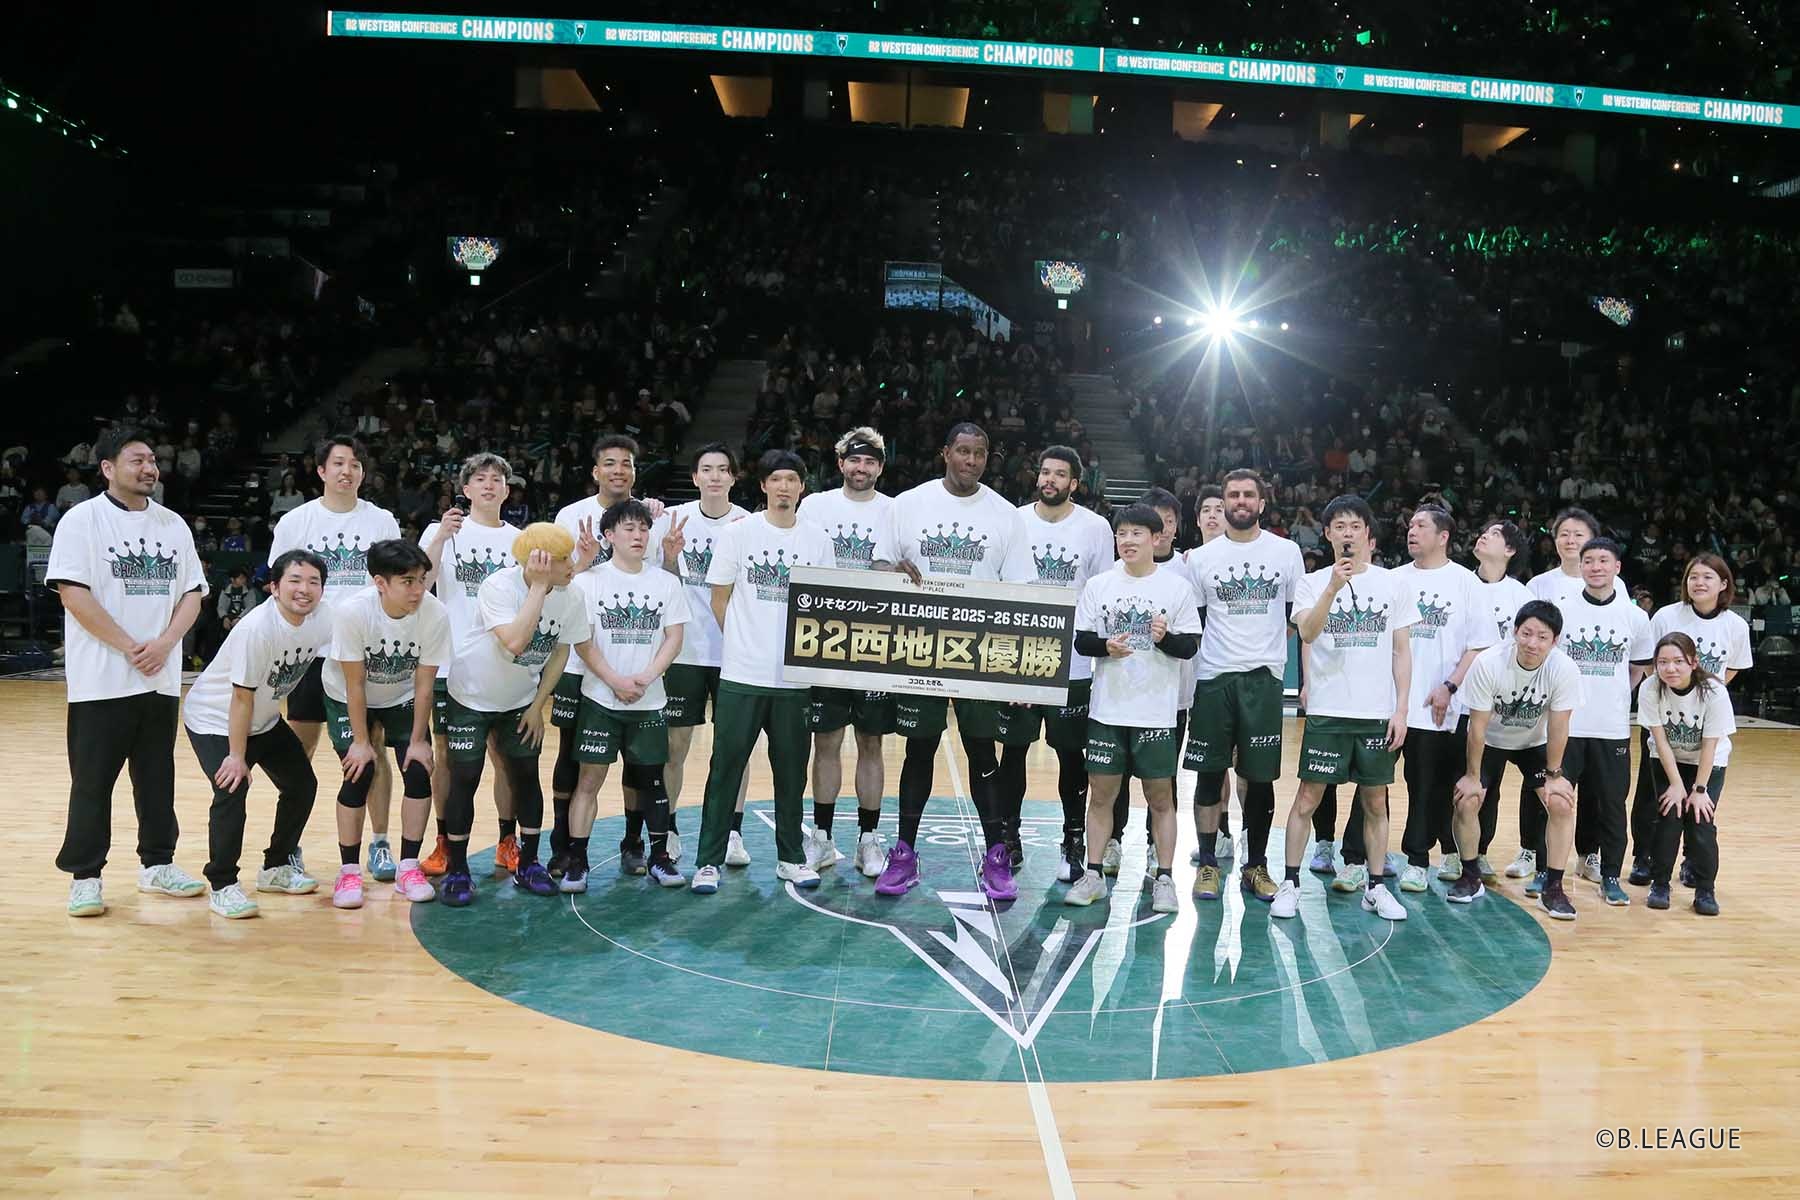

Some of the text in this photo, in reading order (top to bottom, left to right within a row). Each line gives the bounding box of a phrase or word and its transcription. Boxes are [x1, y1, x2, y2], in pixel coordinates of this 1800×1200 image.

[345, 18, 554, 41] B2 WESTERN CONFERENCE CHAMPIONS
[605, 28, 813, 52] B2 WESTERN CONFERENCE CHAMPIONS
[868, 40, 1073, 67] B2 WESTERN CONFERENCE CHAMPIONS
[1116, 55, 1315, 84] B2 WESTERN CONFERENCE CHAMPIONS
[1363, 73, 1553, 104] B2 WESTERN CONFERENCE CHAMPIONS
[1602, 94, 1784, 125] B2 WESTERN CONFERENCE CHAMPIONS
[920, 541, 985, 562] CHAMPIONS
[747, 567, 790, 589] CHAMPI
[1037, 565, 1077, 581] MPIONS
[1216, 584, 1279, 601] CHAMPIONS
[814, 597, 889, 614] りそなグループ
[891, 602, 949, 620] B.LEAGUE
[1012, 612, 1066, 630] SEASON
[793, 617, 1063, 678] B2西地区優勝
[341, 730, 354, 739] KP
[579, 744, 607, 754] KPMG
[1185, 751, 1204, 762] PMG
[1308, 763, 1335, 774] KPMG
